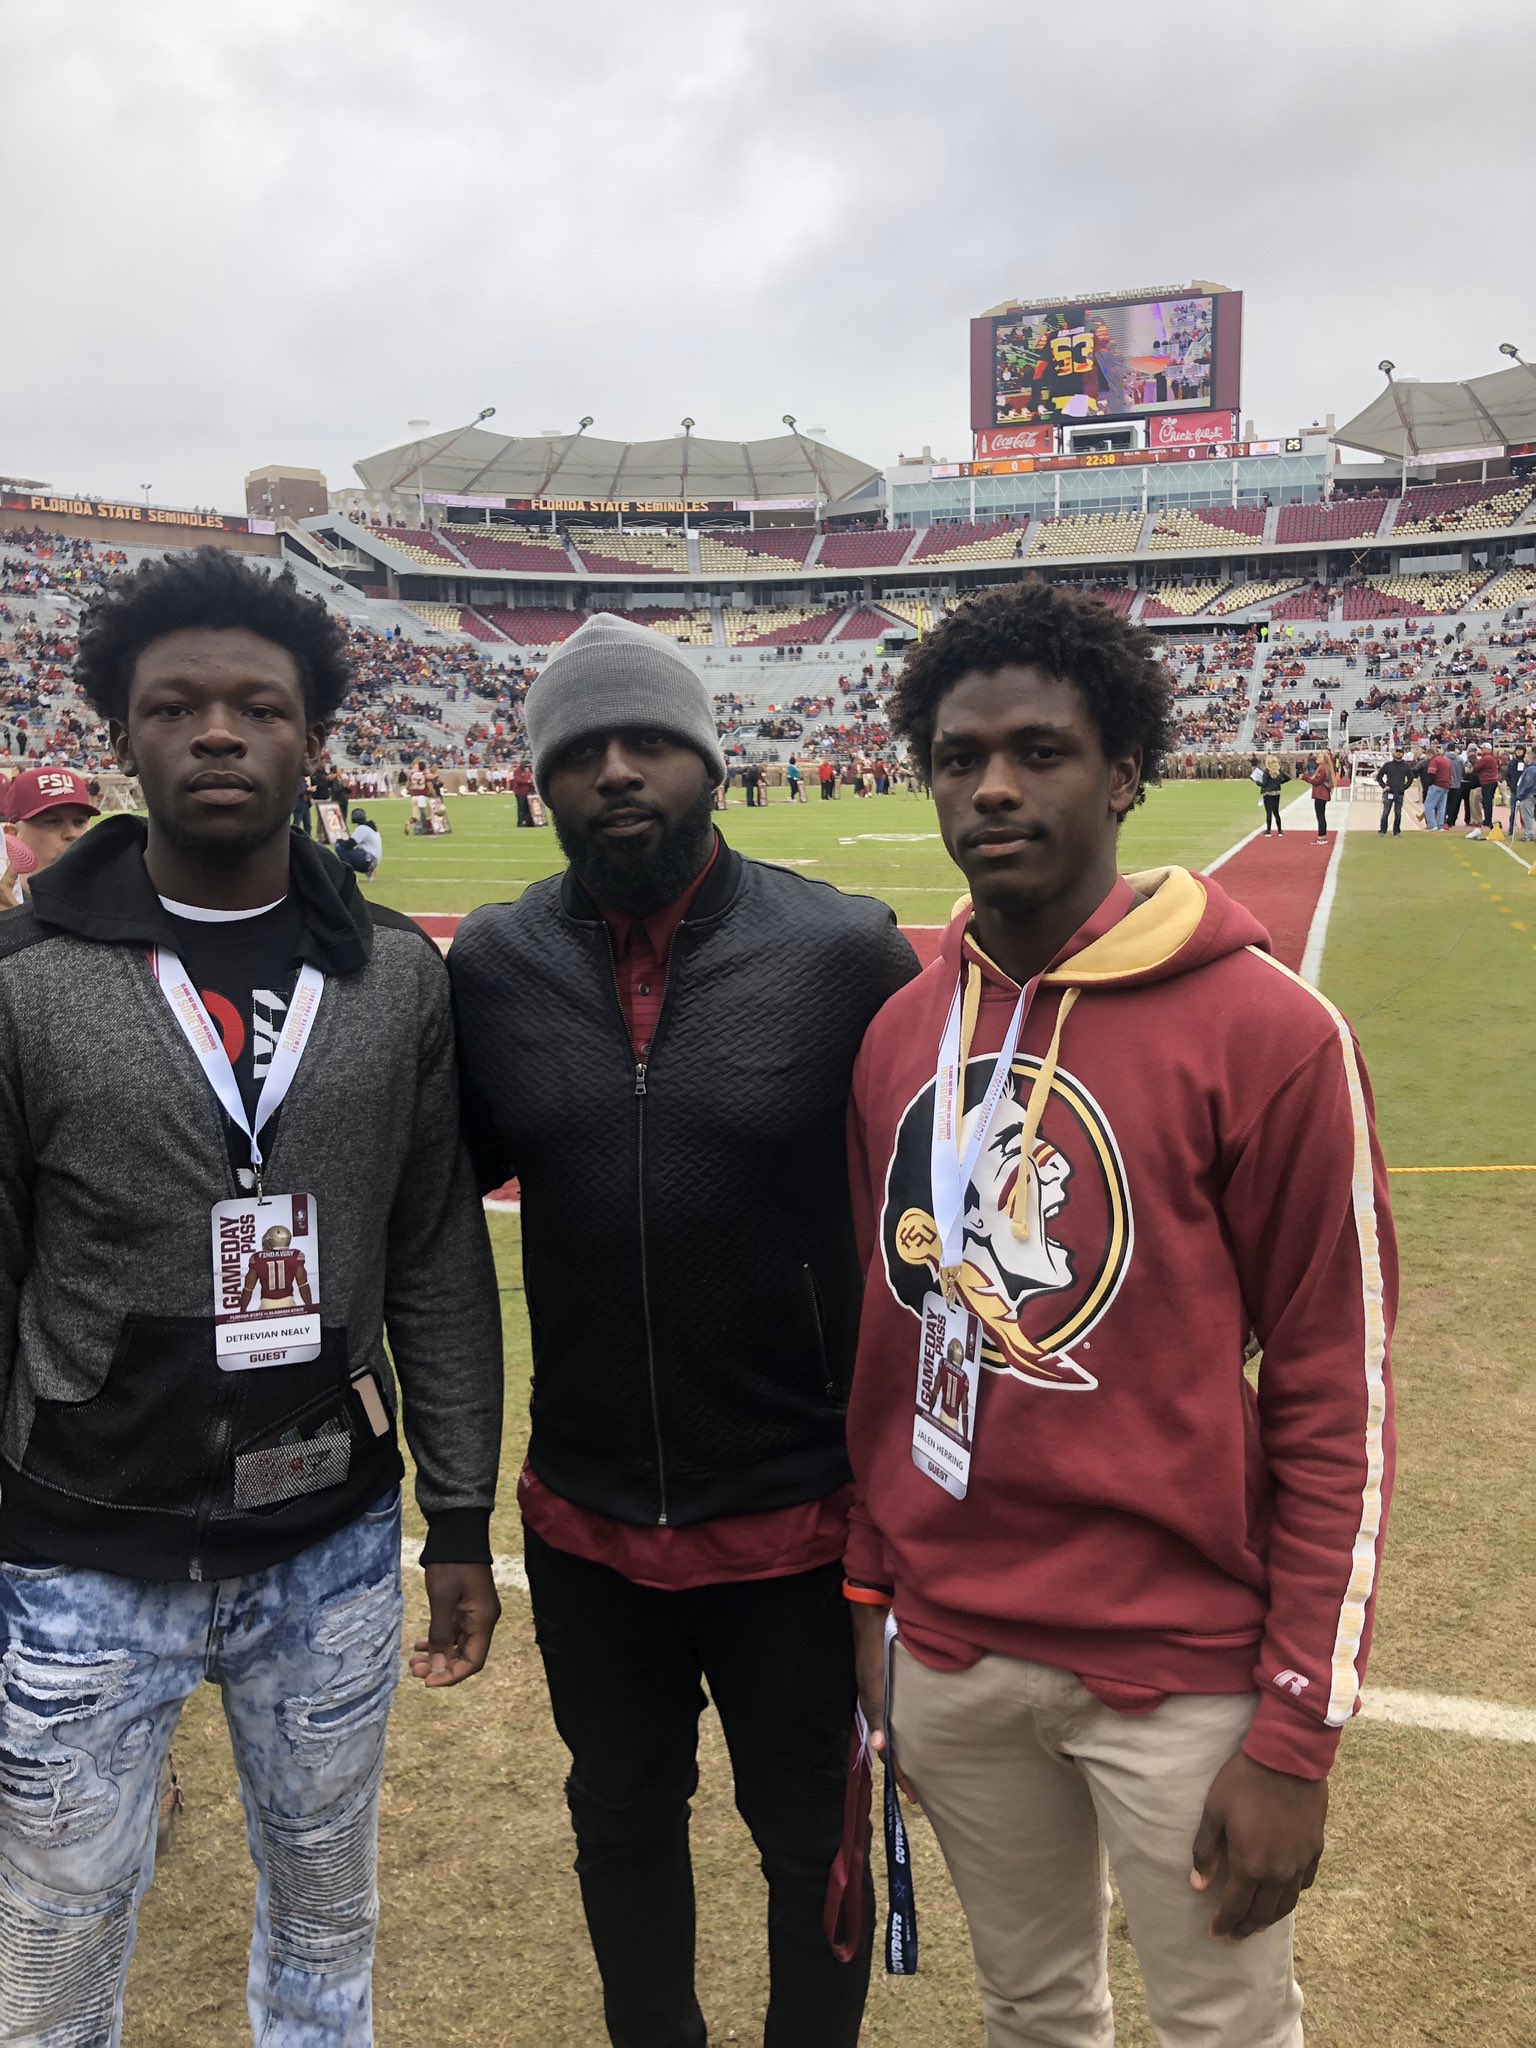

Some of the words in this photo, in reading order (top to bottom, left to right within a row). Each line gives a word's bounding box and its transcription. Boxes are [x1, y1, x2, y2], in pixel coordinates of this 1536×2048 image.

[1021, 296, 1070, 311] FLORIDA
[1074, 291, 1112, 306] STATE
[1116, 283, 1185, 301] UNIVERSITY
[1085, 454, 1116, 466] 22:38
[30, 495, 93, 516] FLORIDA
[97, 504, 142, 521] STATE
[148, 510, 224, 529] SEMINOLES
[531, 500, 586, 512] FLORIDA
[590, 501, 630, 512] STATE
[636, 501, 709, 513] SEMINOLES
[37, 773, 74, 789] FSU
[170, 985, 185, 1001] DO
[176, 998, 213, 1054] SOMETHING
[281, 1012, 303, 1051] FLORIDA
[296, 983, 312, 1012] STATE
[937, 1082, 948, 1141] SOMETHING
[240, 1213, 256, 1254] PASS
[220, 1216, 242, 1310] GAMEDAY
[267, 1259, 286, 1291] 11
[225, 1330, 279, 1344] DETREVIAN
[280, 1326, 311, 1337] NEALY
[935, 1314, 947, 1357] PASS
[249, 1350, 288, 1363] GUEST
[921, 1306, 939, 1408] GAMEDAY
[917, 1429, 936, 1450] JALEN
[936, 1442, 964, 1471] HERRING
[928, 1461, 949, 1484] GUEST
